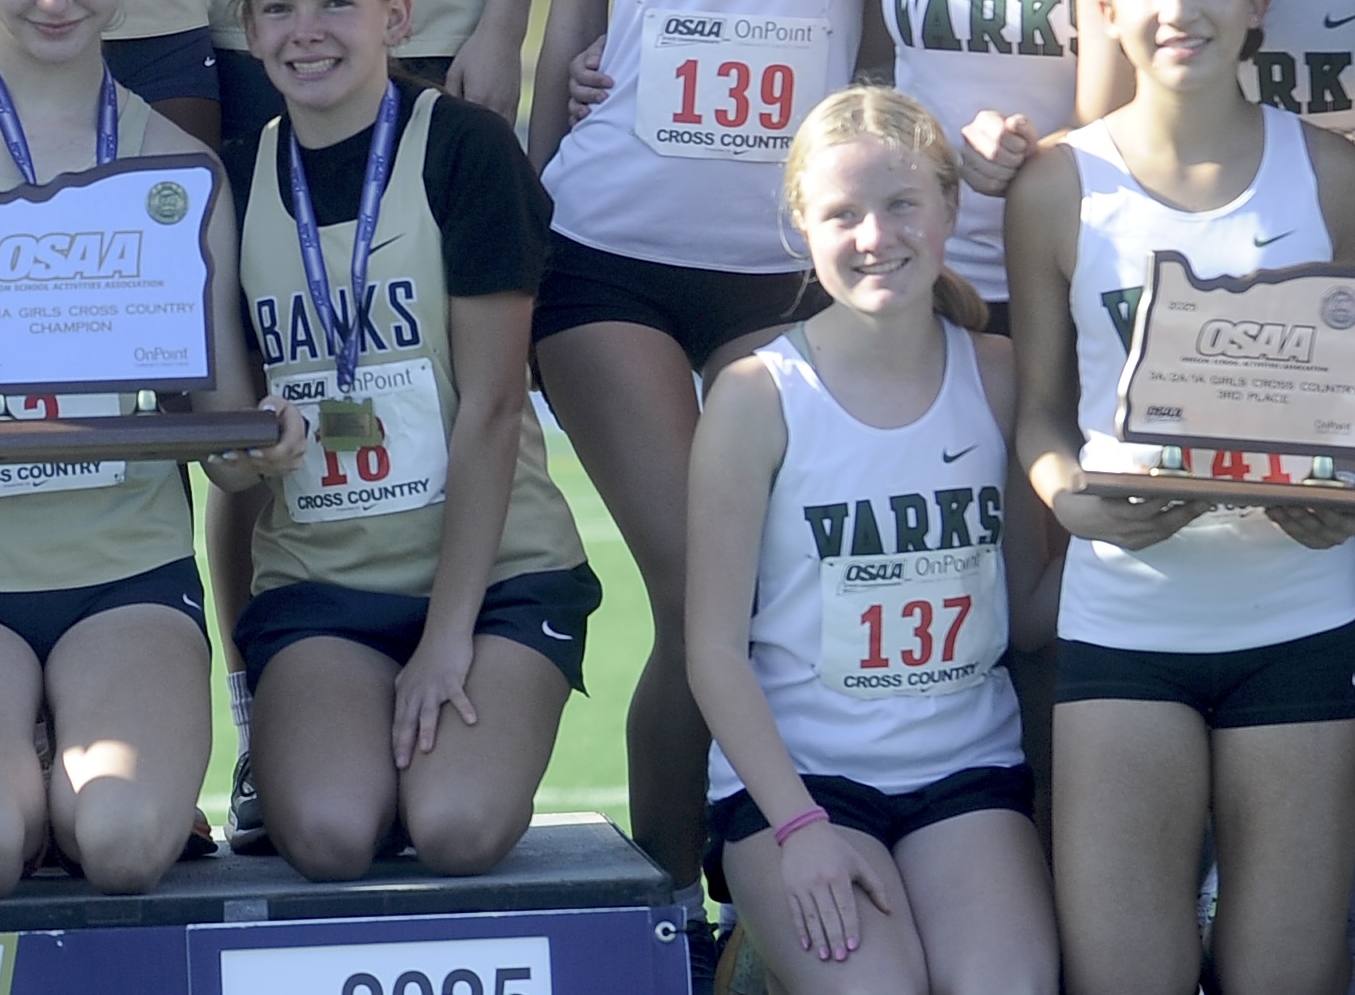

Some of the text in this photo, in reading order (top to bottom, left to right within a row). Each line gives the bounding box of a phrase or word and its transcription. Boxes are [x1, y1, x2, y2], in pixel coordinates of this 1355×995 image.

[664, 18, 723, 38] OSAA
[734, 19, 813, 42] OnPoint
[672, 59, 795, 131] 139
[656, 128, 794, 150] CROSS COUNTR
[18, 306, 62, 319] GIRLS
[68, 305, 119, 317] CROSS
[125, 302, 196, 316] COUNTRY
[29, 321, 113, 334] CHAMPION
[257, 280, 421, 366] BANKS
[1196, 318, 1317, 364] OSAA
[133, 347, 189, 362] OnPoint
[282, 380, 326, 401] OSAA
[17, 461, 101, 481] COUNTRY
[1182, 446, 1291, 485] 41
[297, 478, 430, 511] CROSS COUNTRY
[803, 485, 1002, 560] VARKS
[846, 562, 904, 582] OSAA
[860, 595, 972, 669] 137
[844, 674, 903, 689] CROSS
